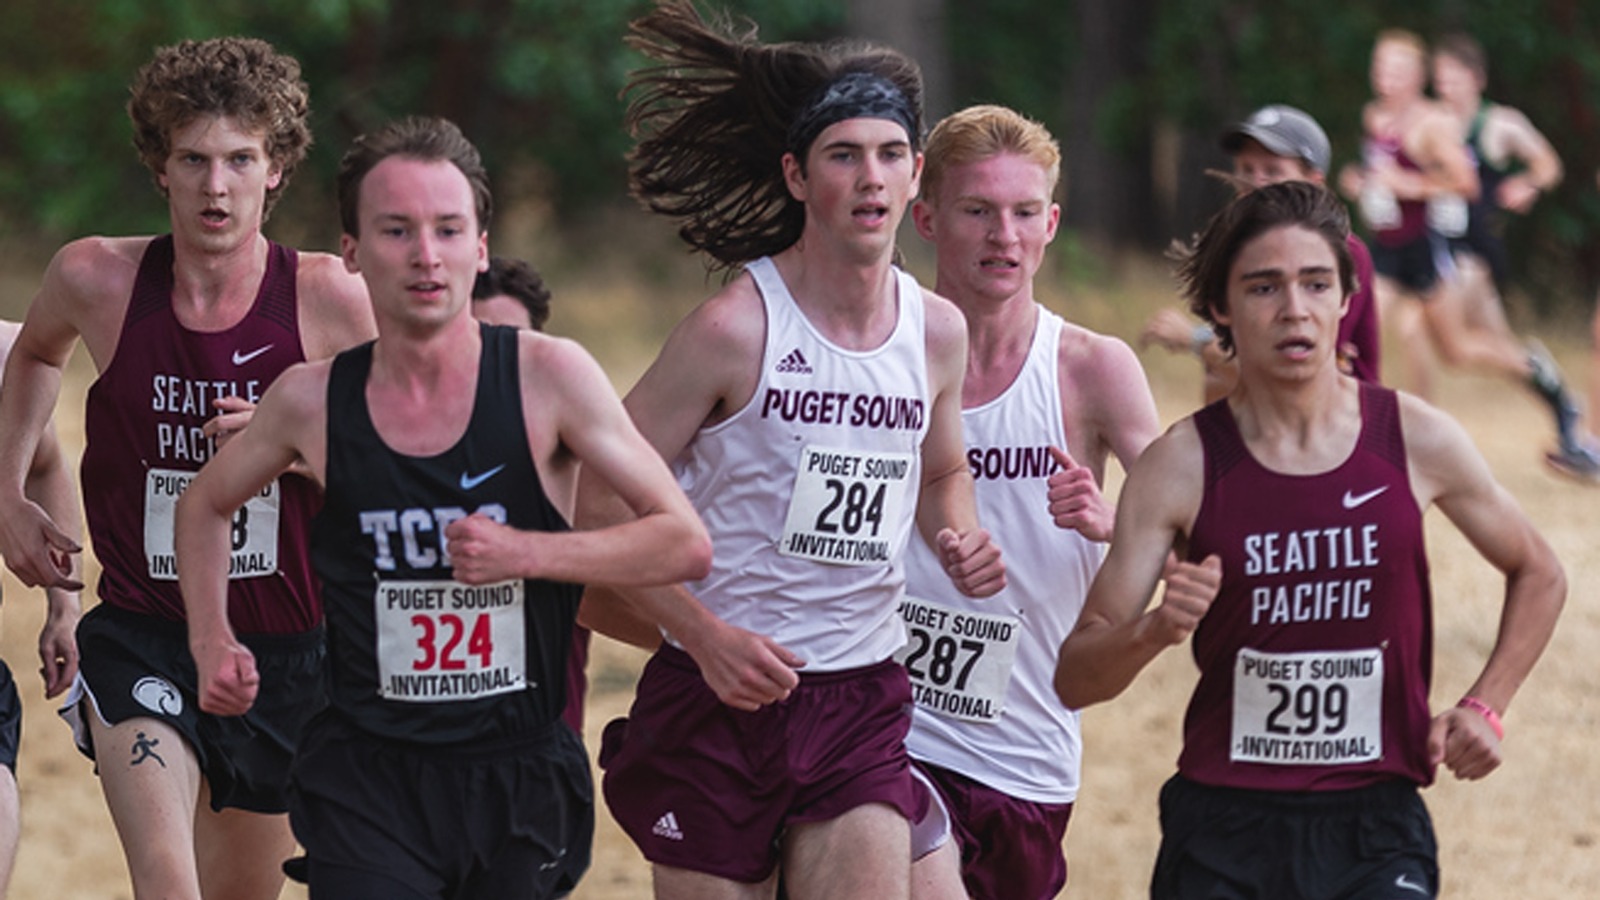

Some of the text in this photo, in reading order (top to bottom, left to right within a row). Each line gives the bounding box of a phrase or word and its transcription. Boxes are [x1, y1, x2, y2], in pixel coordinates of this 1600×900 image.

[153, 374, 260, 416] SEATTE
[761, 388, 924, 431] PUGET SOUND
[158, 423, 215, 463] PACI
[808, 452, 908, 480] PUGET SOUND
[815, 479, 886, 536] 284
[790, 533, 889, 561] INVITATIONAL
[1244, 524, 1380, 576] SEATTLE
[387, 585, 514, 610] PUGET SOUND
[1251, 579, 1372, 625] PACIFIC
[411, 613, 493, 671] 324
[952, 615, 1012, 642] SOUND
[905, 628, 984, 690] 287
[1244, 657, 1374, 680] PUGET SOUND
[391, 667, 514, 695] INVITATIONAL
[910, 682, 993, 718] TATIONAL
[1265, 683, 1348, 736] 299
[1243, 736, 1371, 760] INVITATIONAL
